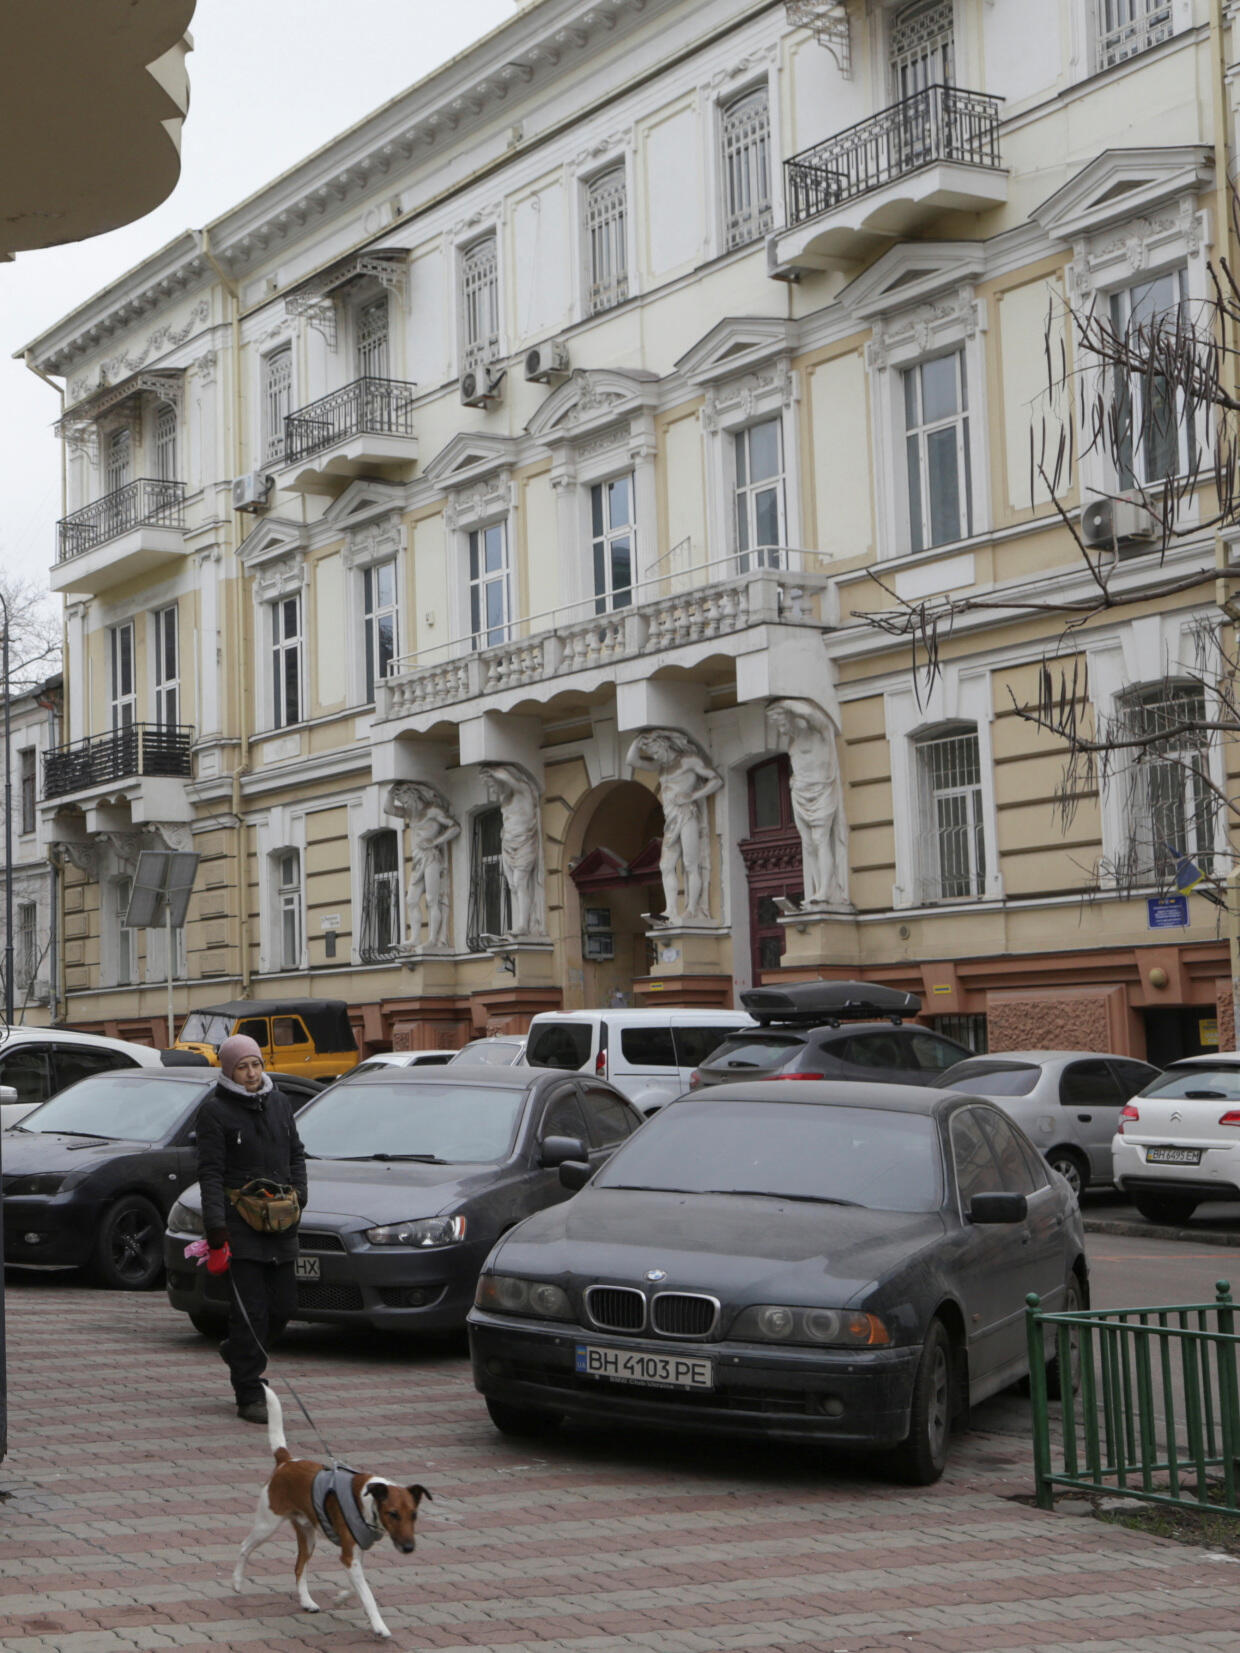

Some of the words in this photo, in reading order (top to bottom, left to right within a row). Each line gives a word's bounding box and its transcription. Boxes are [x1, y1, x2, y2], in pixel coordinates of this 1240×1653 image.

[1186, 1151, 1199, 1161] EM
[295, 1259, 319, 1275] HX
[588, 1350, 619, 1373] BH
[623, 1355, 671, 1380] 4103
[675, 1361, 707, 1385] PE
